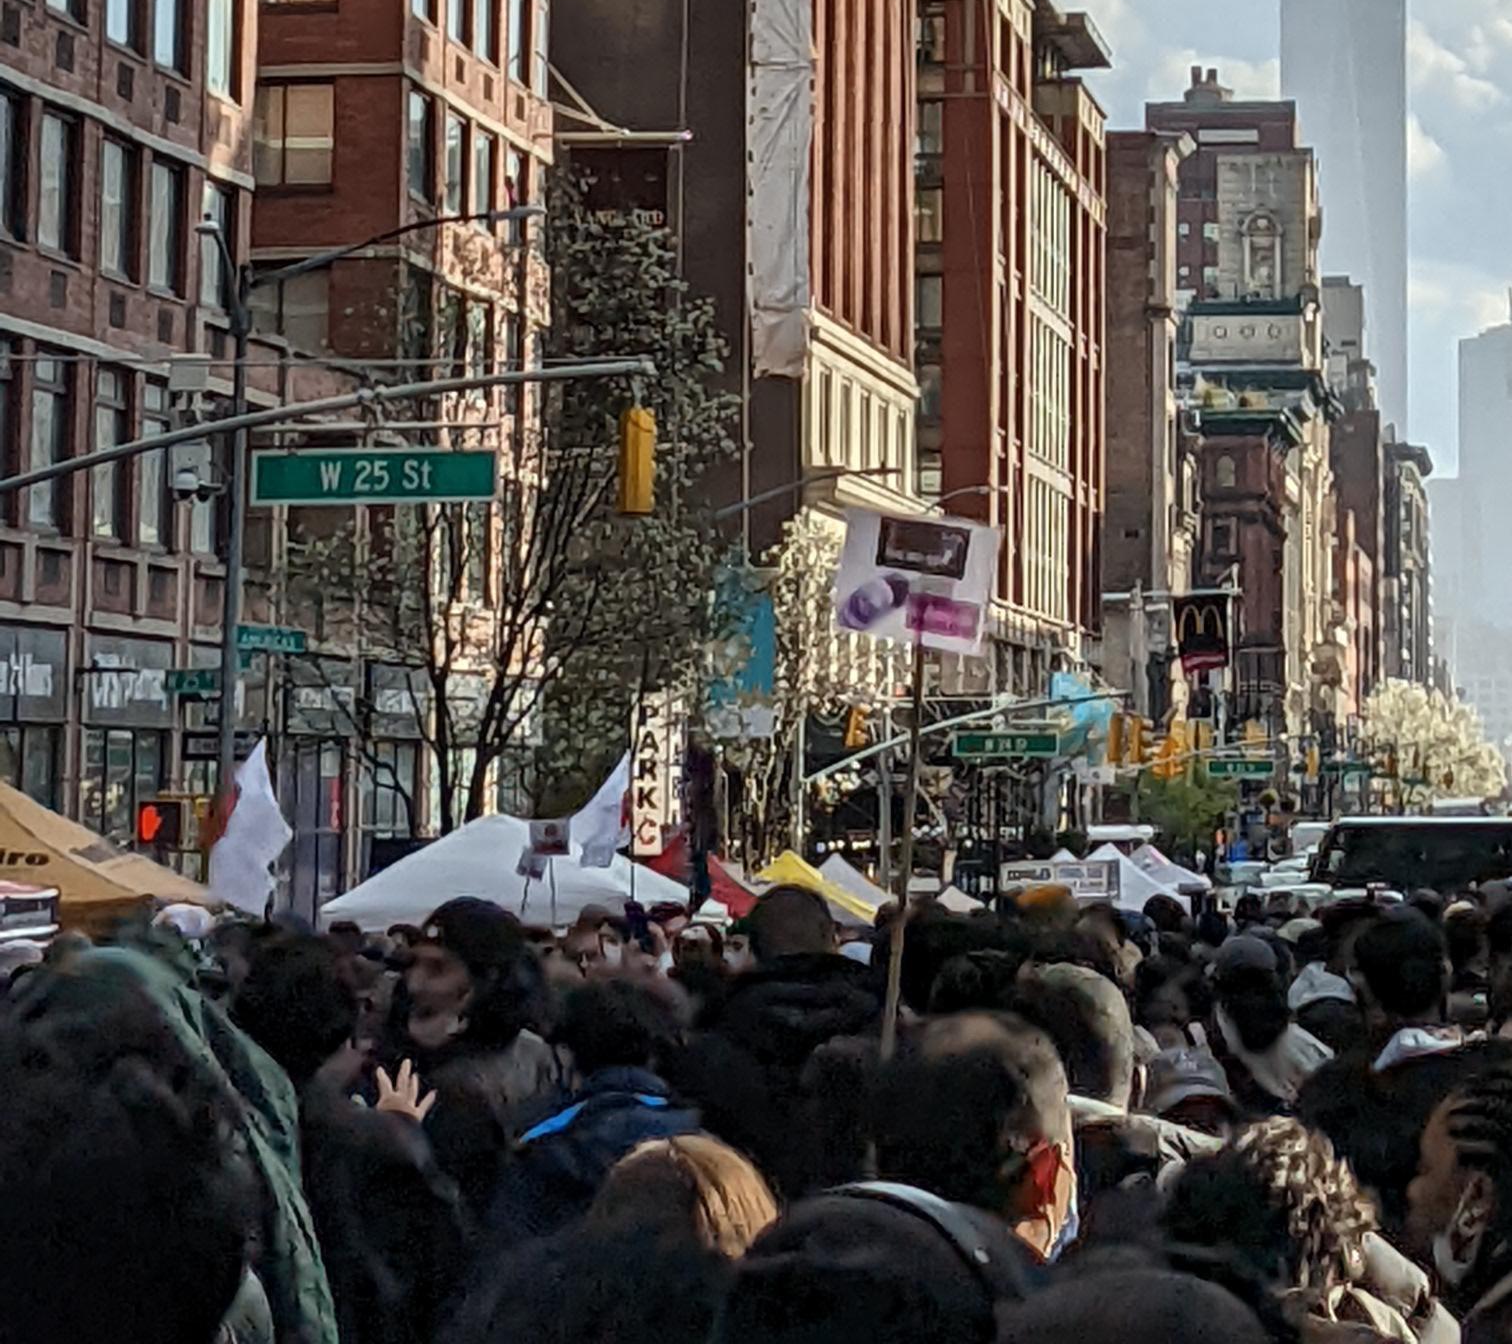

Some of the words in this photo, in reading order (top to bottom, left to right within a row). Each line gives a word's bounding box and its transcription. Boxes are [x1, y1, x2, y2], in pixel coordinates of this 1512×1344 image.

[319, 460, 342, 492] W
[353, 460, 390, 492] 25
[401, 459, 433, 490] St
[638, 704, 659, 810] PARK
